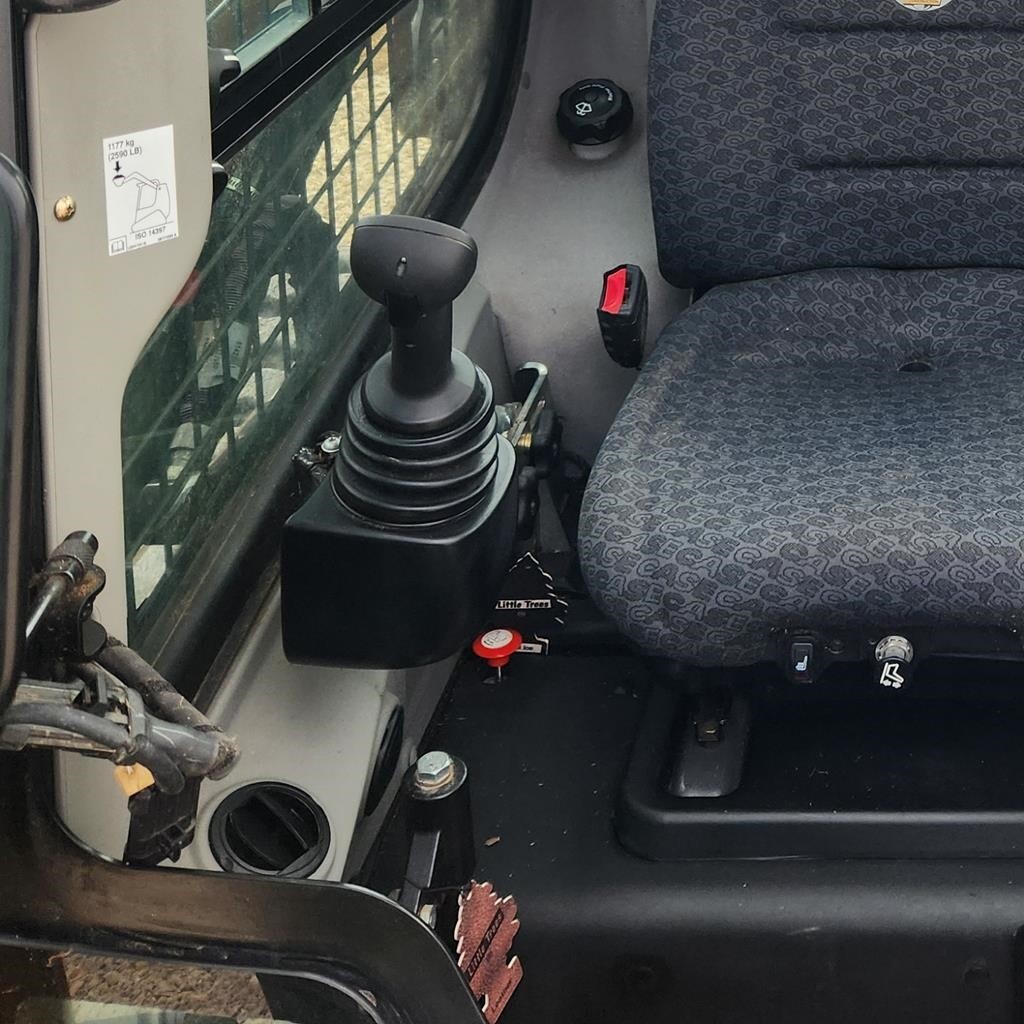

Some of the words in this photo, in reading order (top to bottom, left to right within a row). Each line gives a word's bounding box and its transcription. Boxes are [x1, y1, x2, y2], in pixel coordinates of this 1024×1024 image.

[108, 140, 124, 150] 1177
[125, 139, 135, 148] kg
[108, 149, 128, 162] (2590
[129, 145, 142, 156] LB)
[135, 231, 147, 240] ISO
[498, 600, 523, 608] Little
[524, 600, 549, 608] Trees
